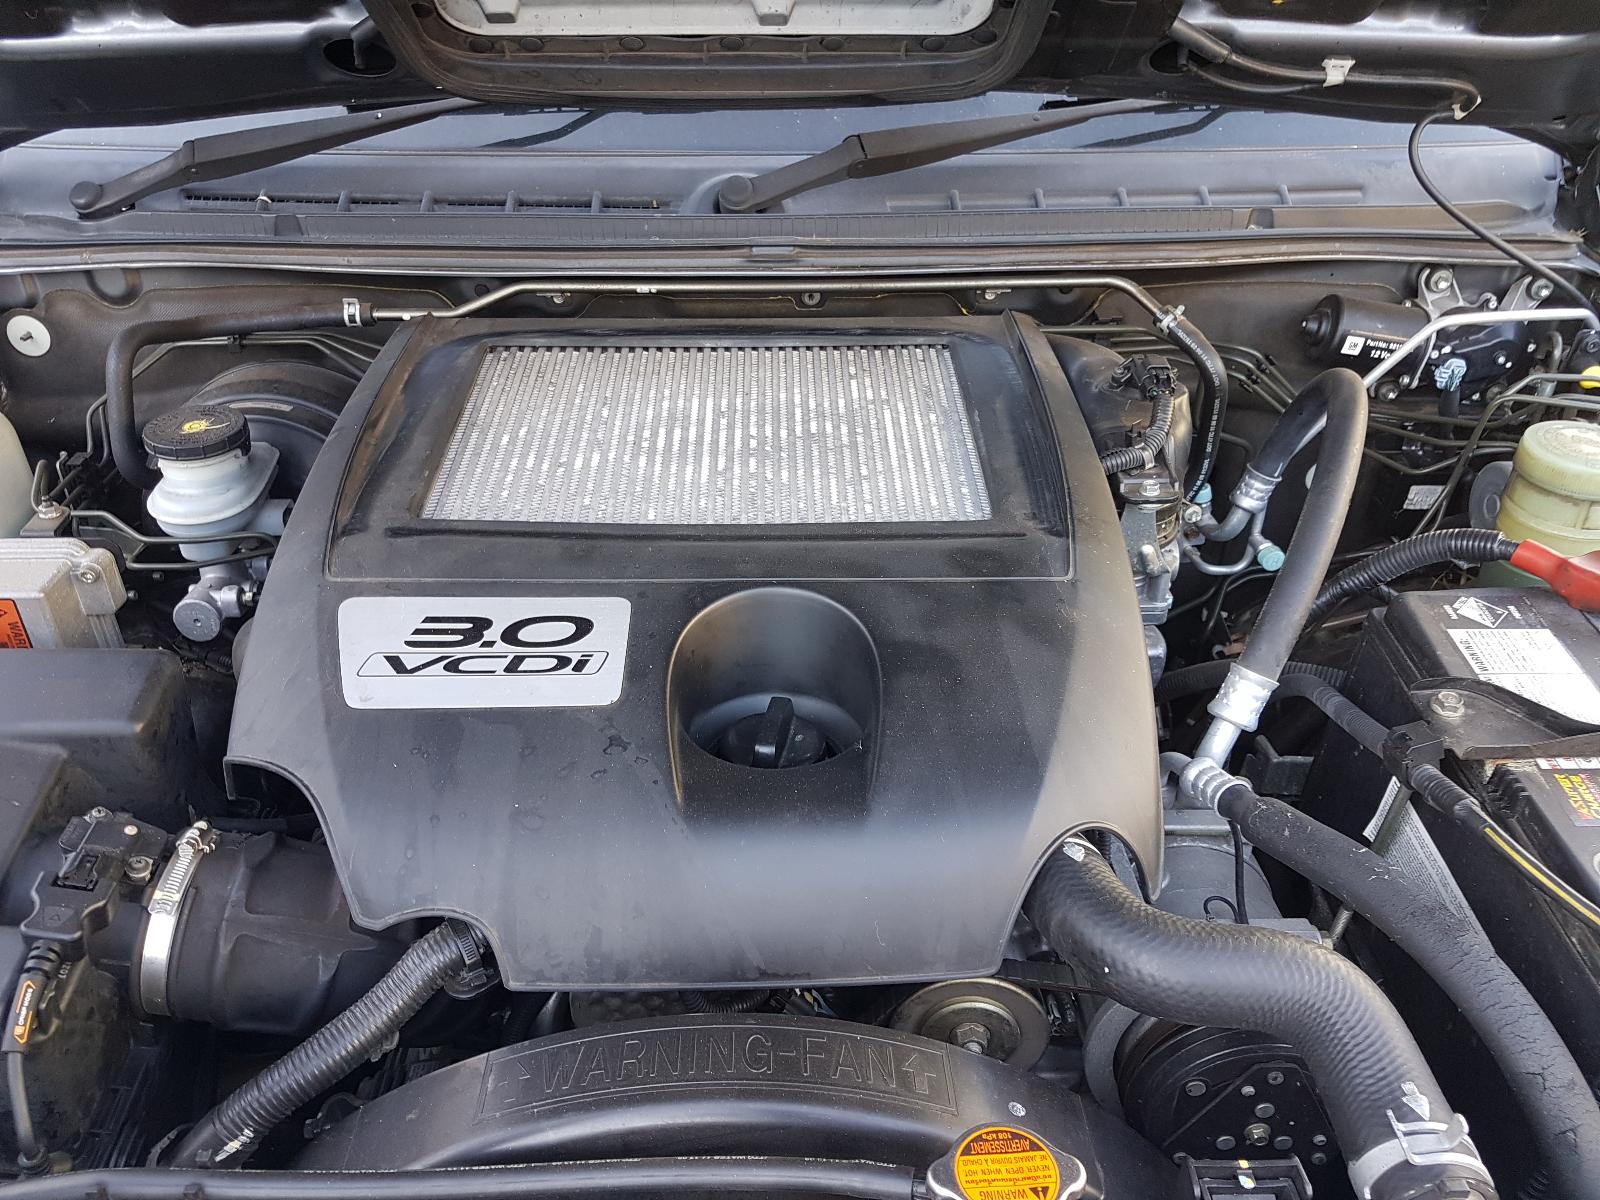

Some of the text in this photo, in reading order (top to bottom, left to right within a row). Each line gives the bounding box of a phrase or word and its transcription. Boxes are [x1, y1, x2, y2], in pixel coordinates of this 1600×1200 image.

[8, 621, 29, 648] WAR
[403, 615, 595, 648] 3.0
[383, 653, 595, 675] VCDi
[970, 1139, 1031, 1154] AVERTISSEMENT
[1013, 1155, 1037, 1164] JAMAIS
[981, 1168, 1003, 1178] WHEN
[1005, 1166, 1025, 1176] OPEN
[1027, 1164, 1051, 1174] NEVER
[979, 1188, 1028, 1200] WARNING
